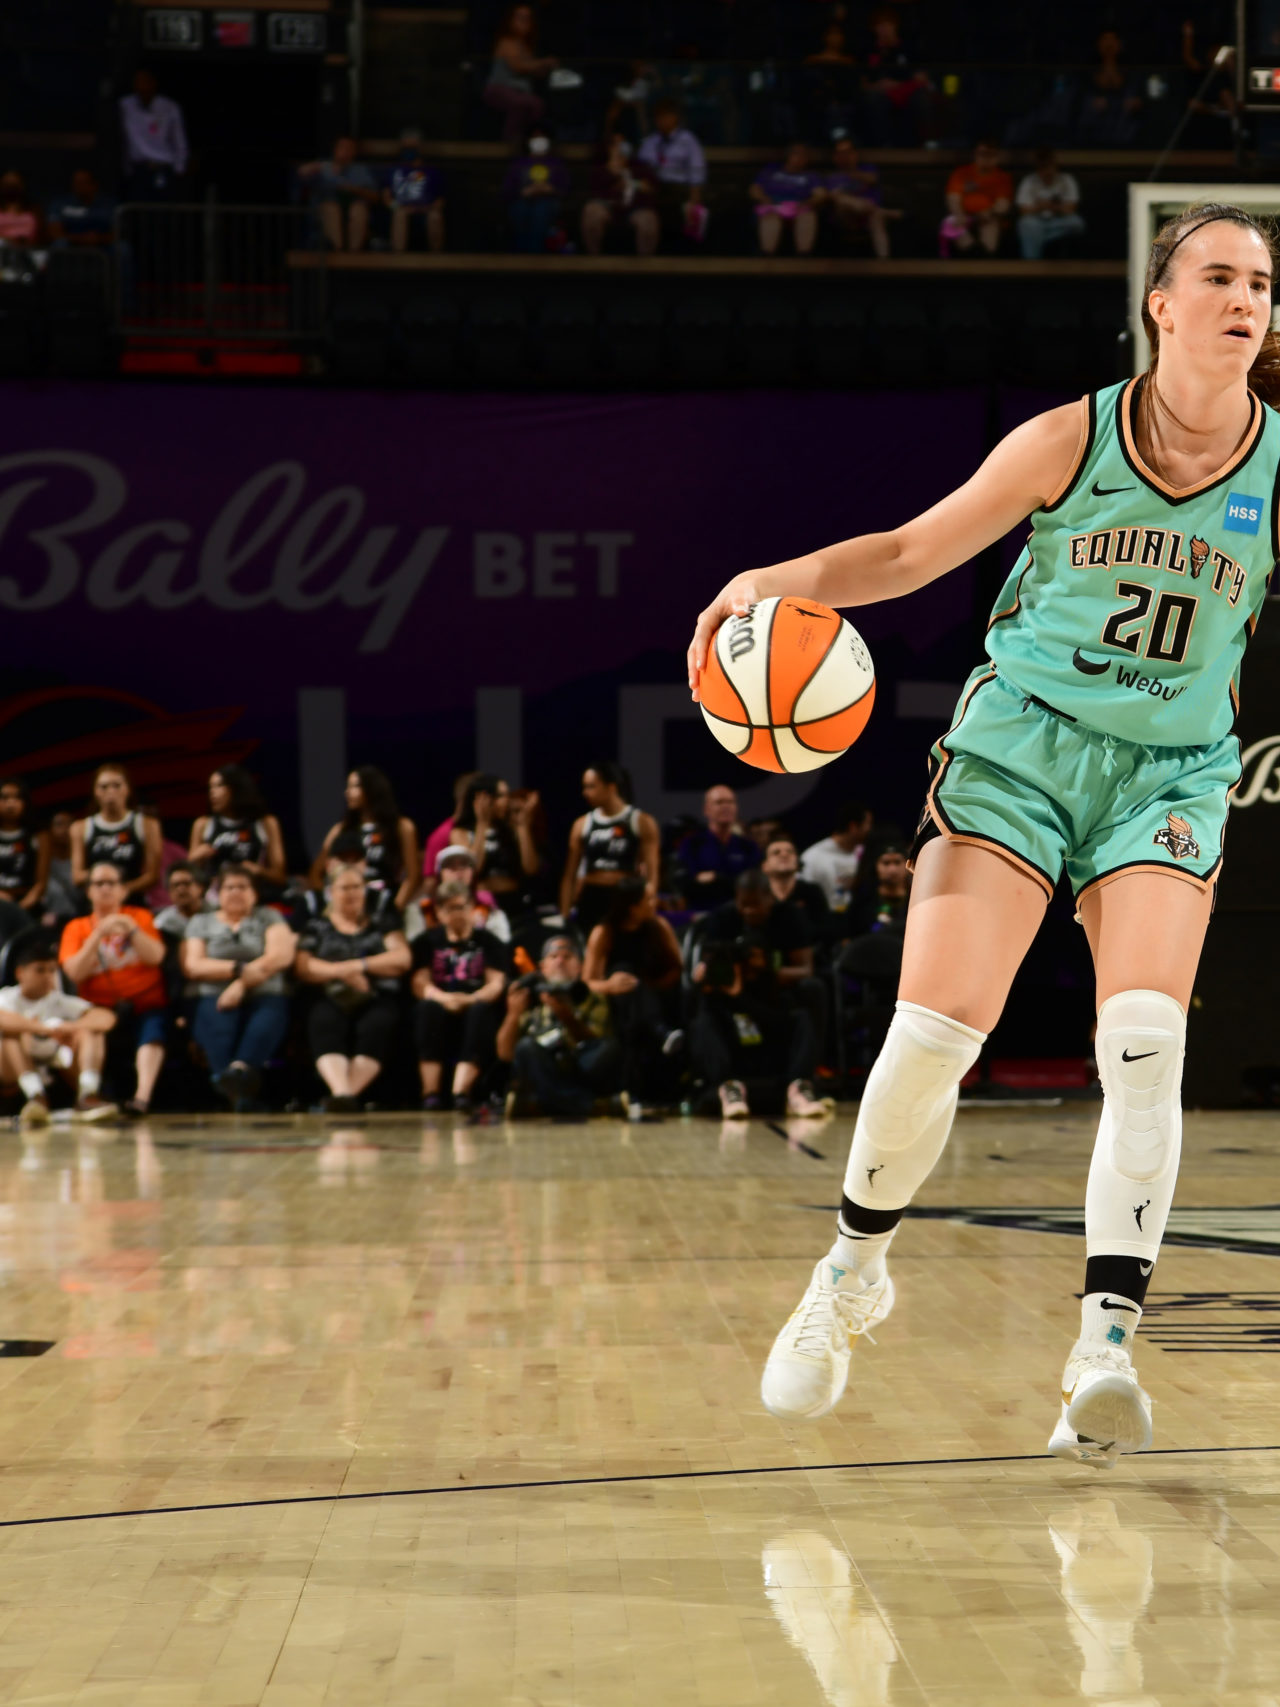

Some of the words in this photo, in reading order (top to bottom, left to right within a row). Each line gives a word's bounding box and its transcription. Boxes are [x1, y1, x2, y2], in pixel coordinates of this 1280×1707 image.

[0, 449, 452, 654] Bally
[472, 530, 635, 599] BET
[1228, 504, 1258, 521] HSS
[1100, 579, 1200, 665] 20
